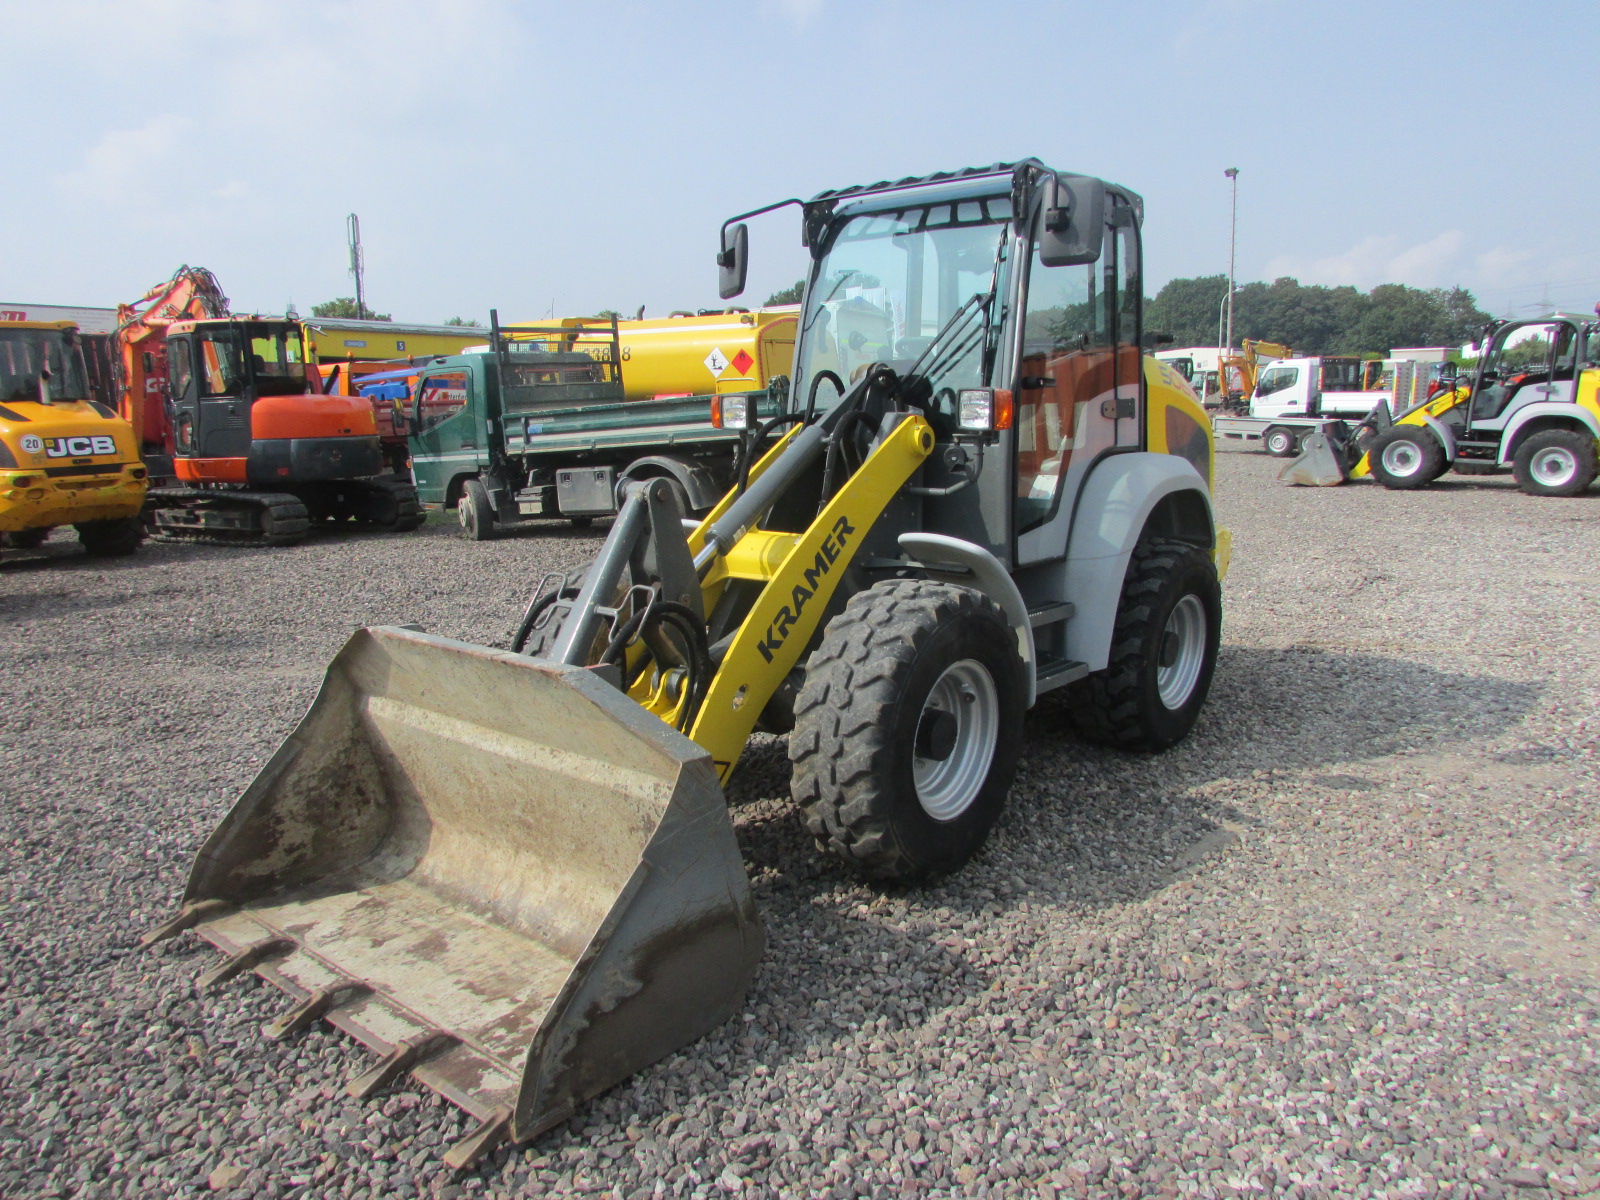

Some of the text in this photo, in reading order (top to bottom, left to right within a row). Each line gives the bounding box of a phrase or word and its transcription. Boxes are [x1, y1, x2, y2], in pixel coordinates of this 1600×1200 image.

[25, 439, 39, 449] 20
[47, 436, 116, 457] JCB
[756, 515, 856, 664] KRAMER
